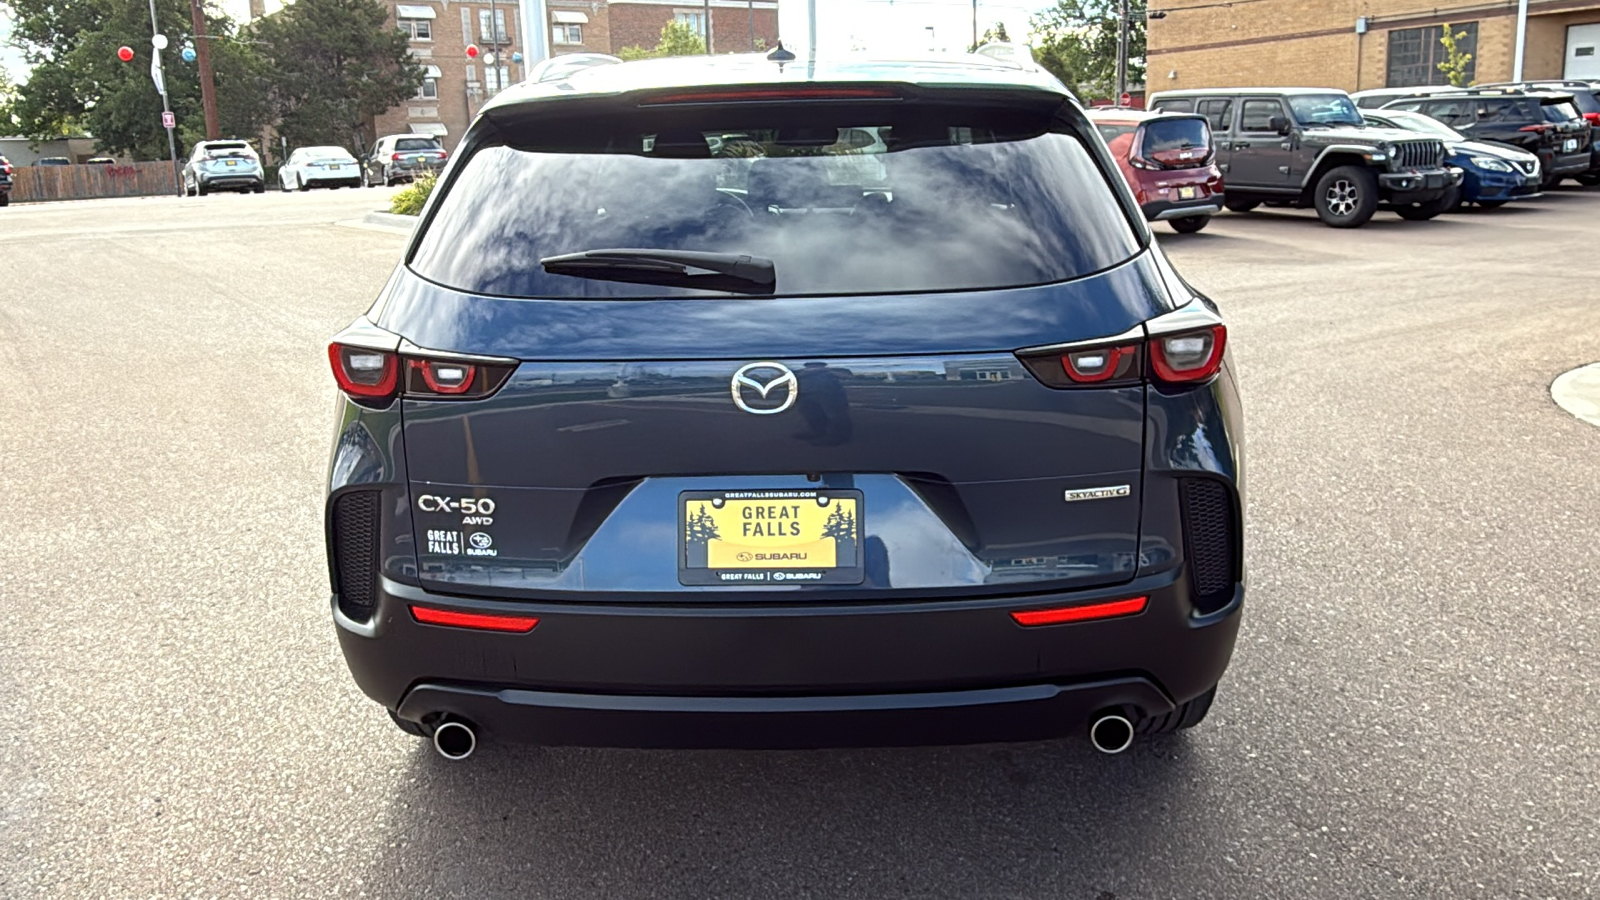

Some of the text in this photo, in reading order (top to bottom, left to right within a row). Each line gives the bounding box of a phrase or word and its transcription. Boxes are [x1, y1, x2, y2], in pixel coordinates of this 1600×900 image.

[724, 491, 817, 499] GREATFALLSSUBARU.COM
[417, 494, 496, 515] CX-50
[742, 505, 801, 520] GREAT
[462, 516, 494, 525] AWD
[742, 521, 801, 537] FALLS
[427, 529, 458, 542] GREAT
[428, 541, 460, 555] FALLS
[466, 548, 498, 556] SUBARU
[754, 552, 808, 561] SUBARU
[720, 572, 822, 580] GREAT FALLS SUBARU
